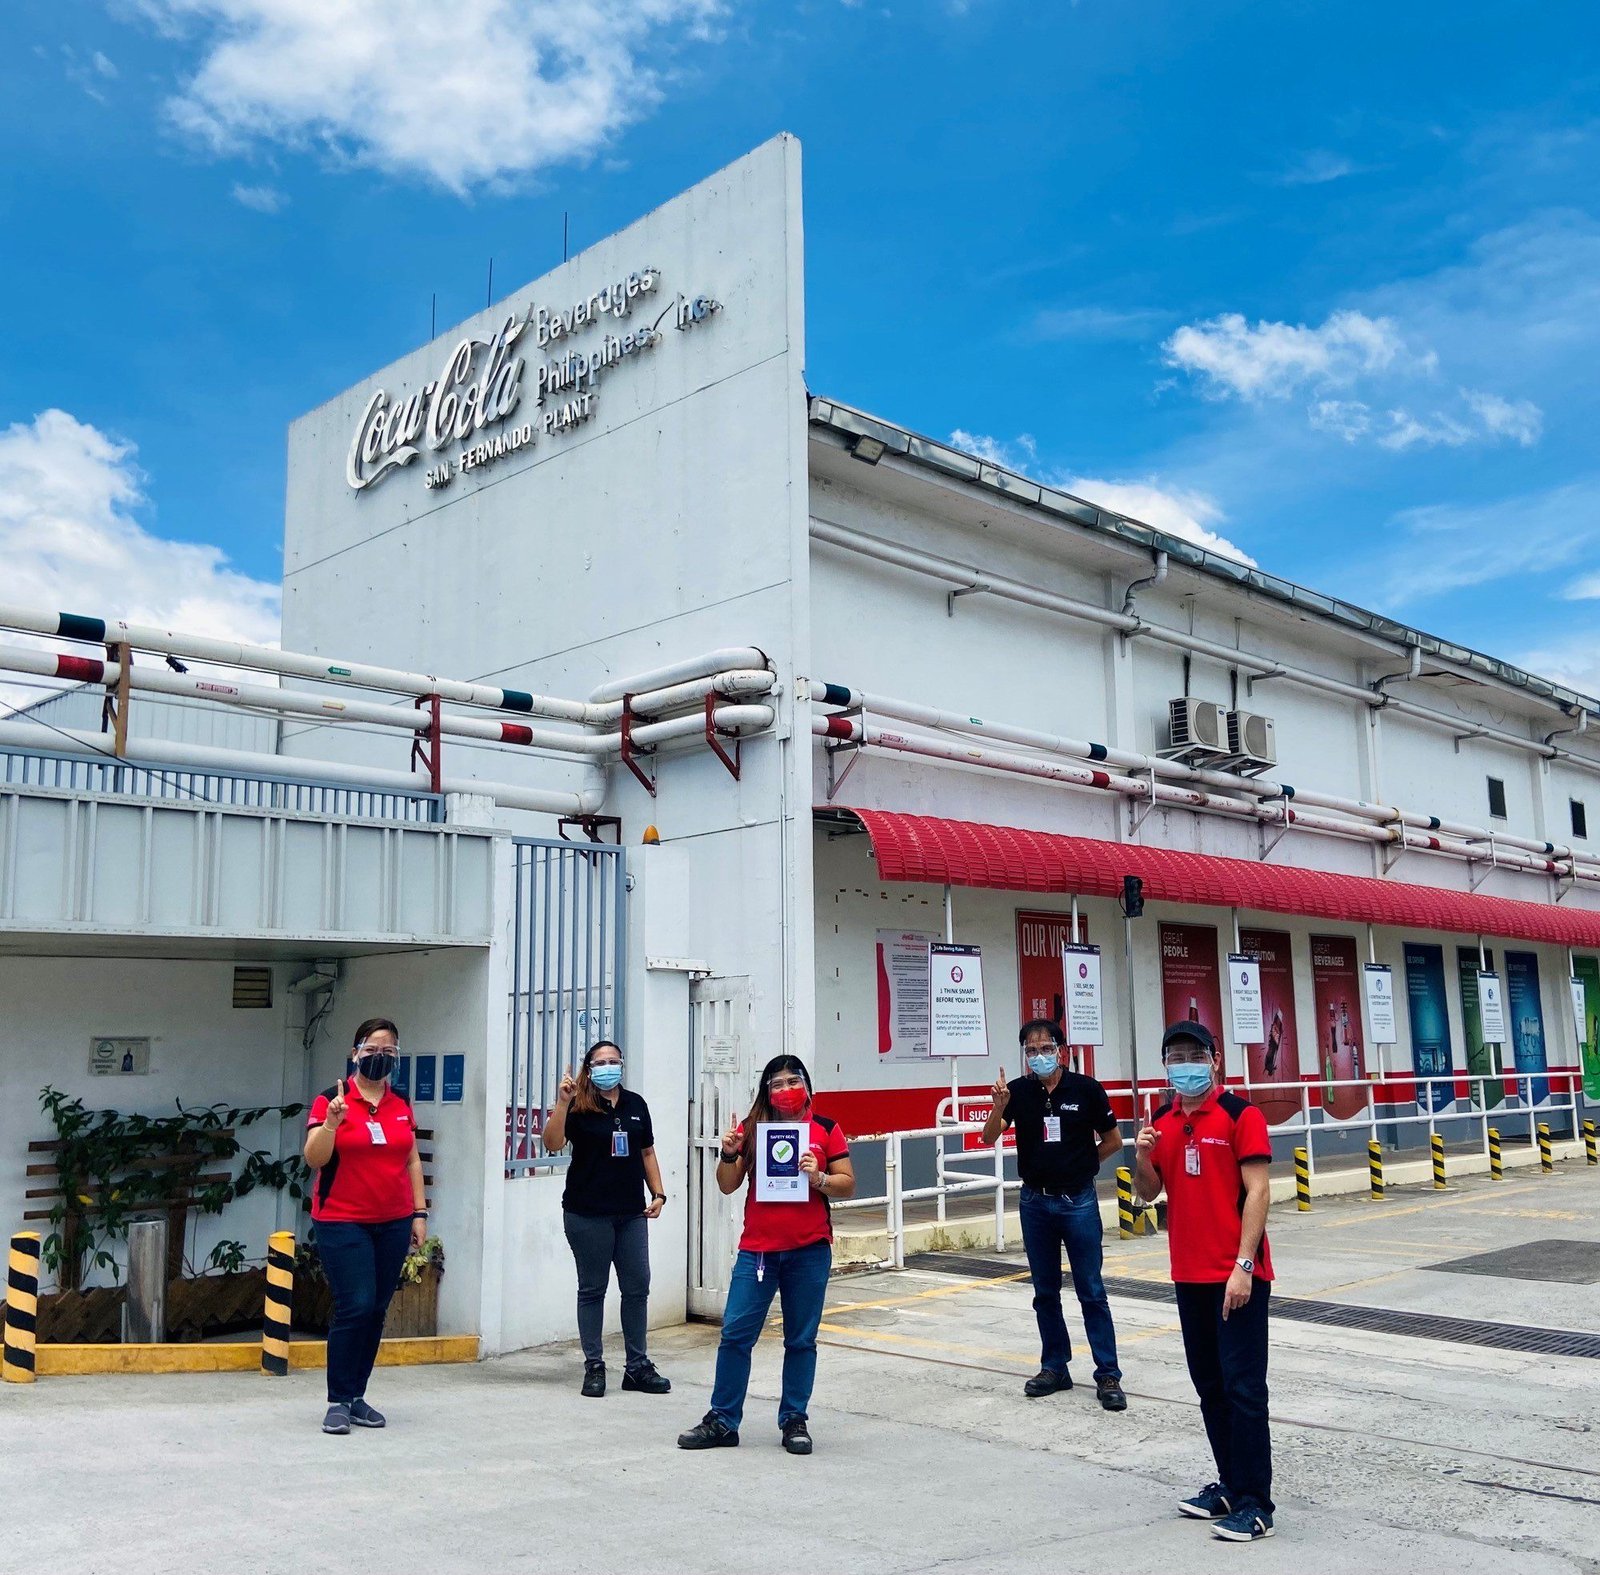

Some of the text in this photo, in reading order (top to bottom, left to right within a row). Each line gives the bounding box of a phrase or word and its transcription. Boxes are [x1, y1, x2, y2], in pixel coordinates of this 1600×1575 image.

[537, 265, 658, 349] Beverages
[424, 393, 594, 489] SAN FERNANDO PLANT
[1023, 923, 1046, 957] OUR
[1164, 932, 1183, 944] GREAT
[1164, 946, 1188, 957] PEOPLE
[1314, 955, 1344, 966] BEVERAGES
